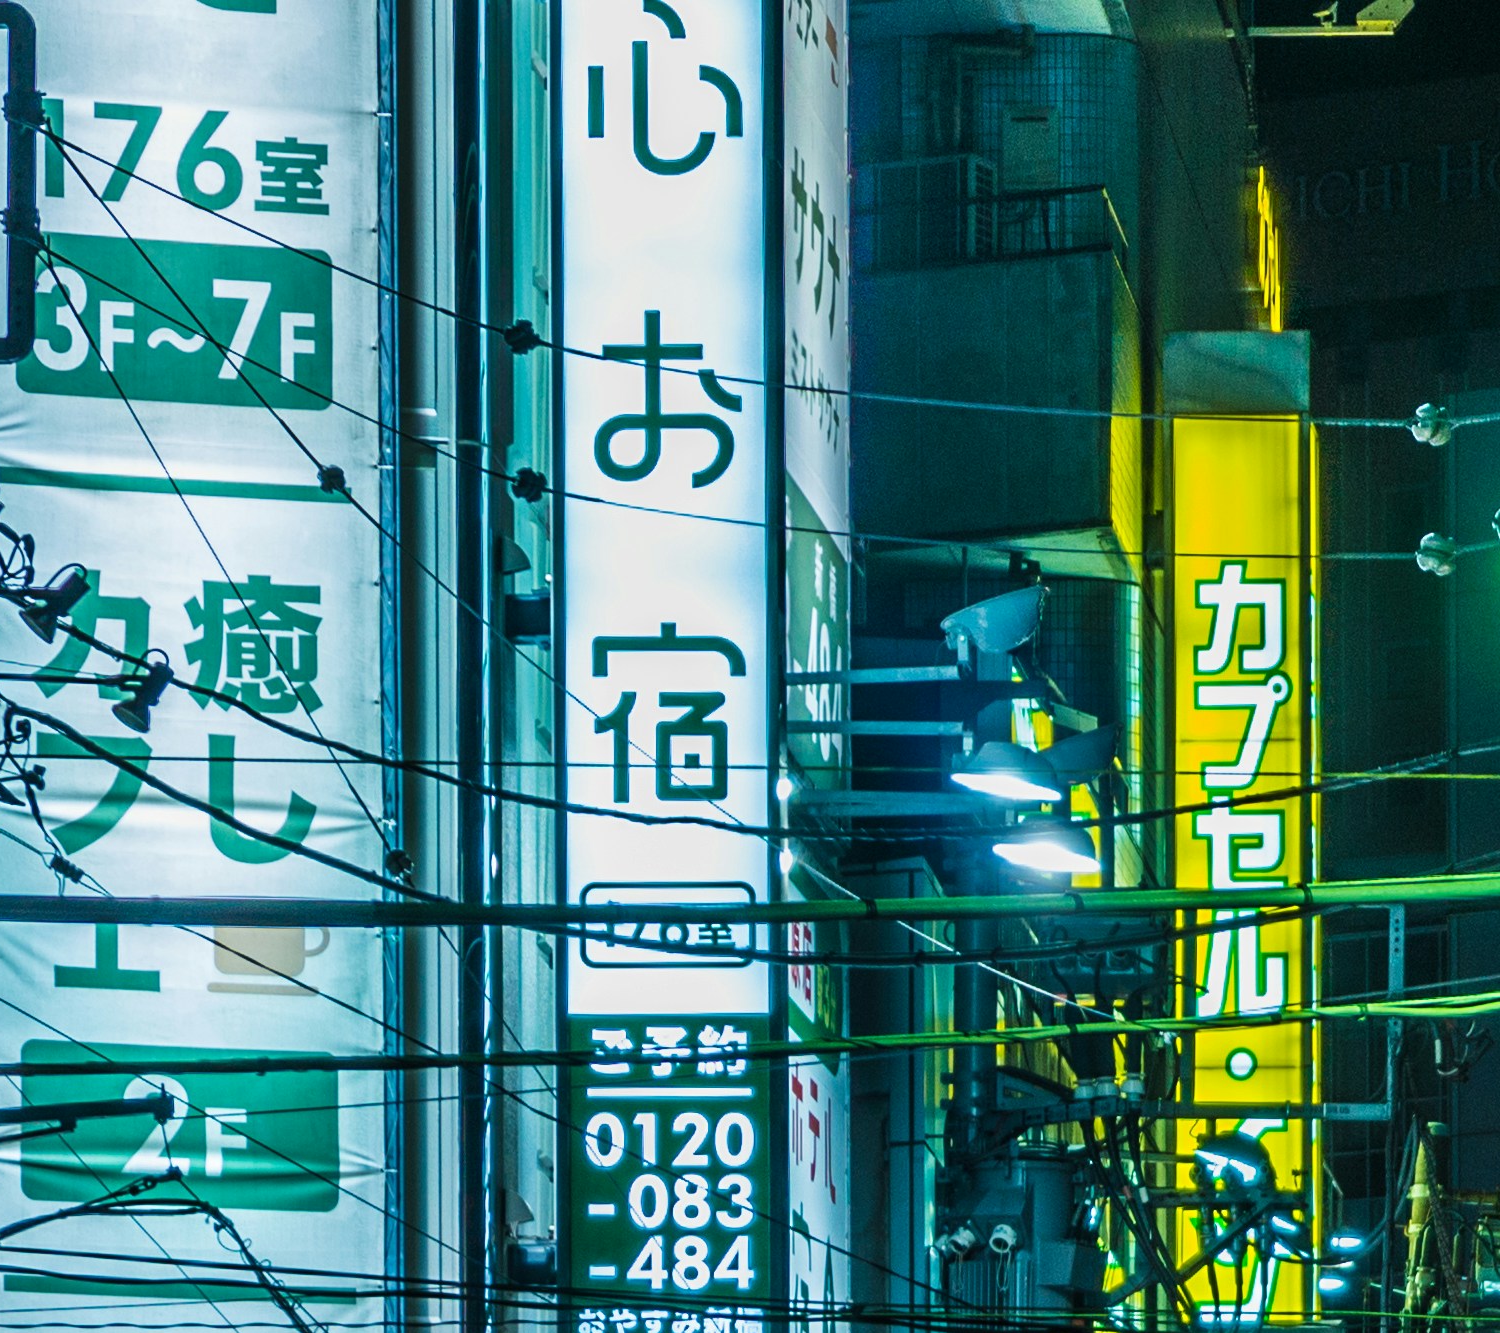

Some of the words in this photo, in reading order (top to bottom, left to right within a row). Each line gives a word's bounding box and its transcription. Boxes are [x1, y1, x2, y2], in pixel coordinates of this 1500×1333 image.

[791, 145, 841, 340] サウナ
[791, 327, 841, 456] ミストサウナ
[183, 573, 322, 865] 癒し
[1195, 560, 1289, 1324] カプセル・ン
[590, 1023, 750, 1081] ご予約
[122, 1074, 248, 1178] 2F
[585, 1111, 757, 1169] 0120
[587, 1173, 756, 1230] -083
[588, 1234, 756, 1292] -484
